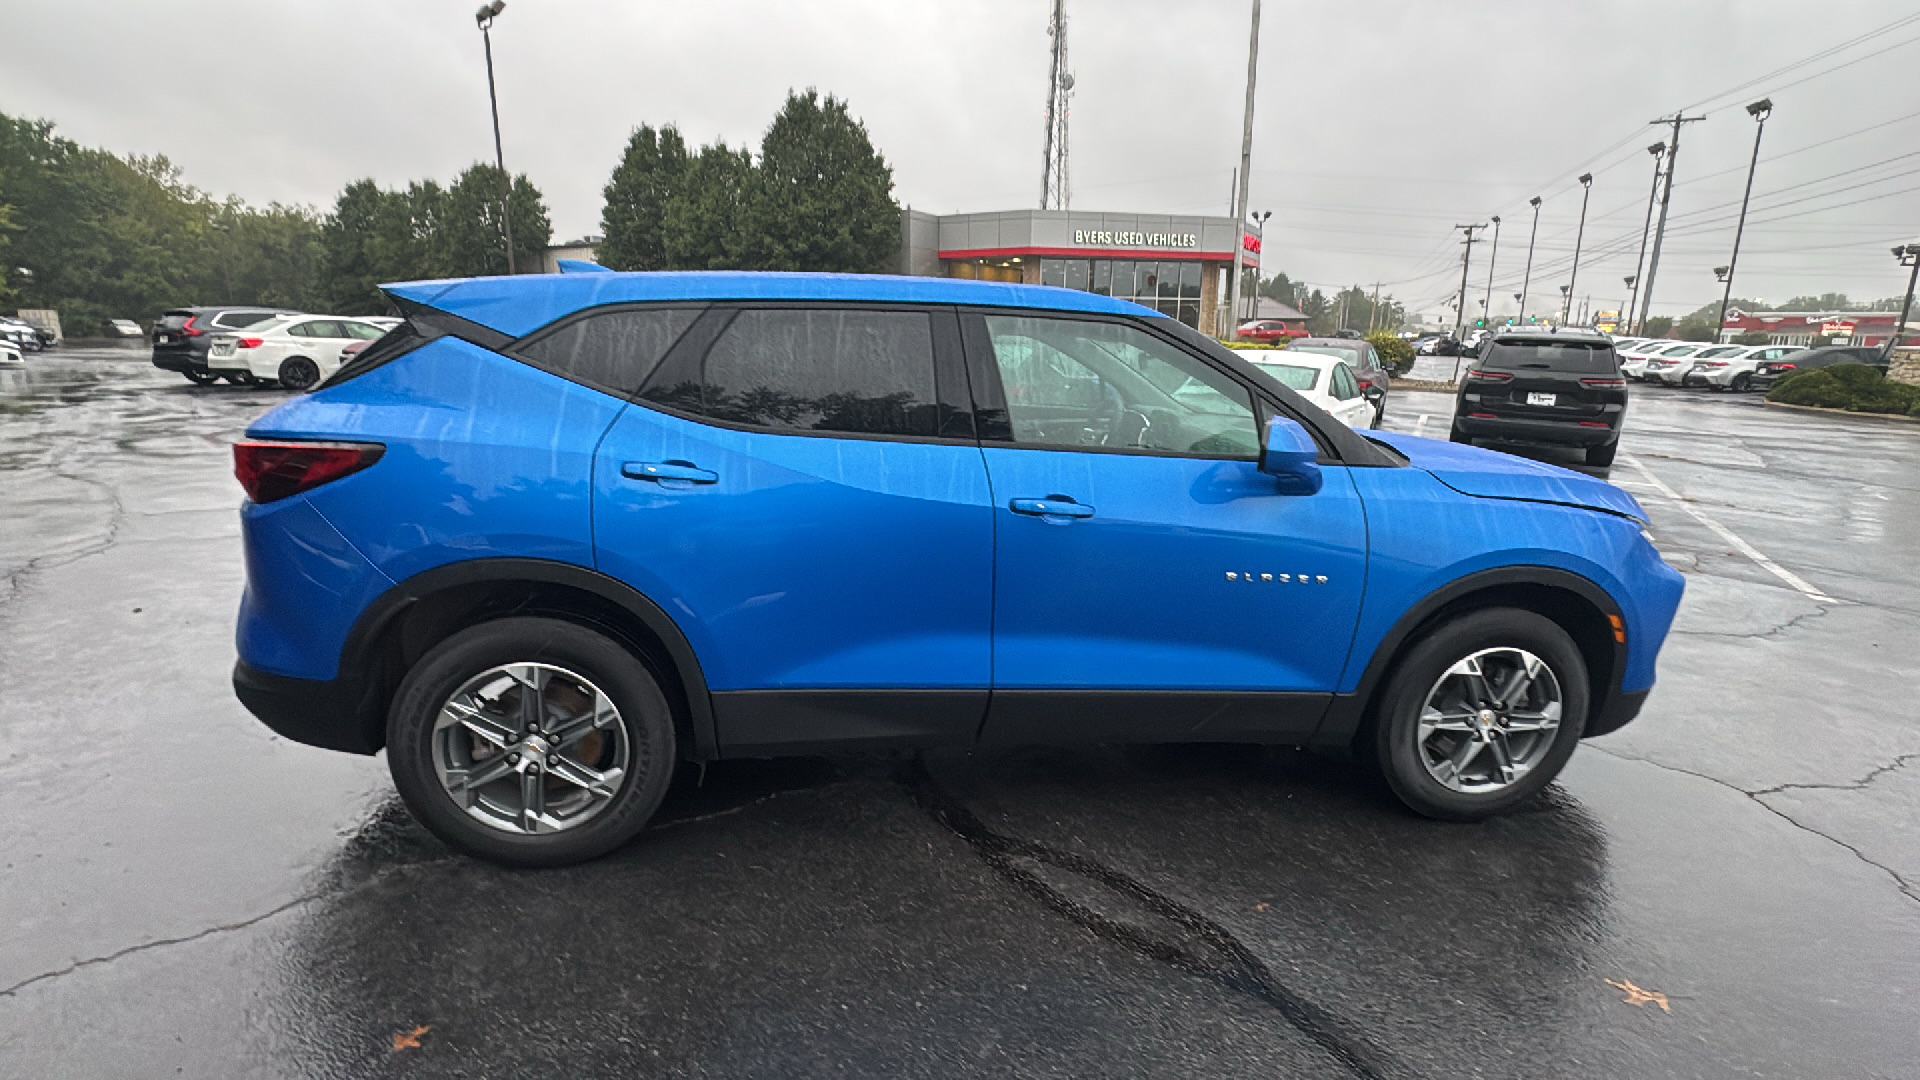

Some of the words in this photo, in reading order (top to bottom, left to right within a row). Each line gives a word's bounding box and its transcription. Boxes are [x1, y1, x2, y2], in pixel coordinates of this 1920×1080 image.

[1075, 229, 1111, 245] BYERS
[1114, 231, 1143, 246] USED
[1145, 233, 1196, 248] VEHICLES
[1225, 571, 1329, 585] BLAZER
